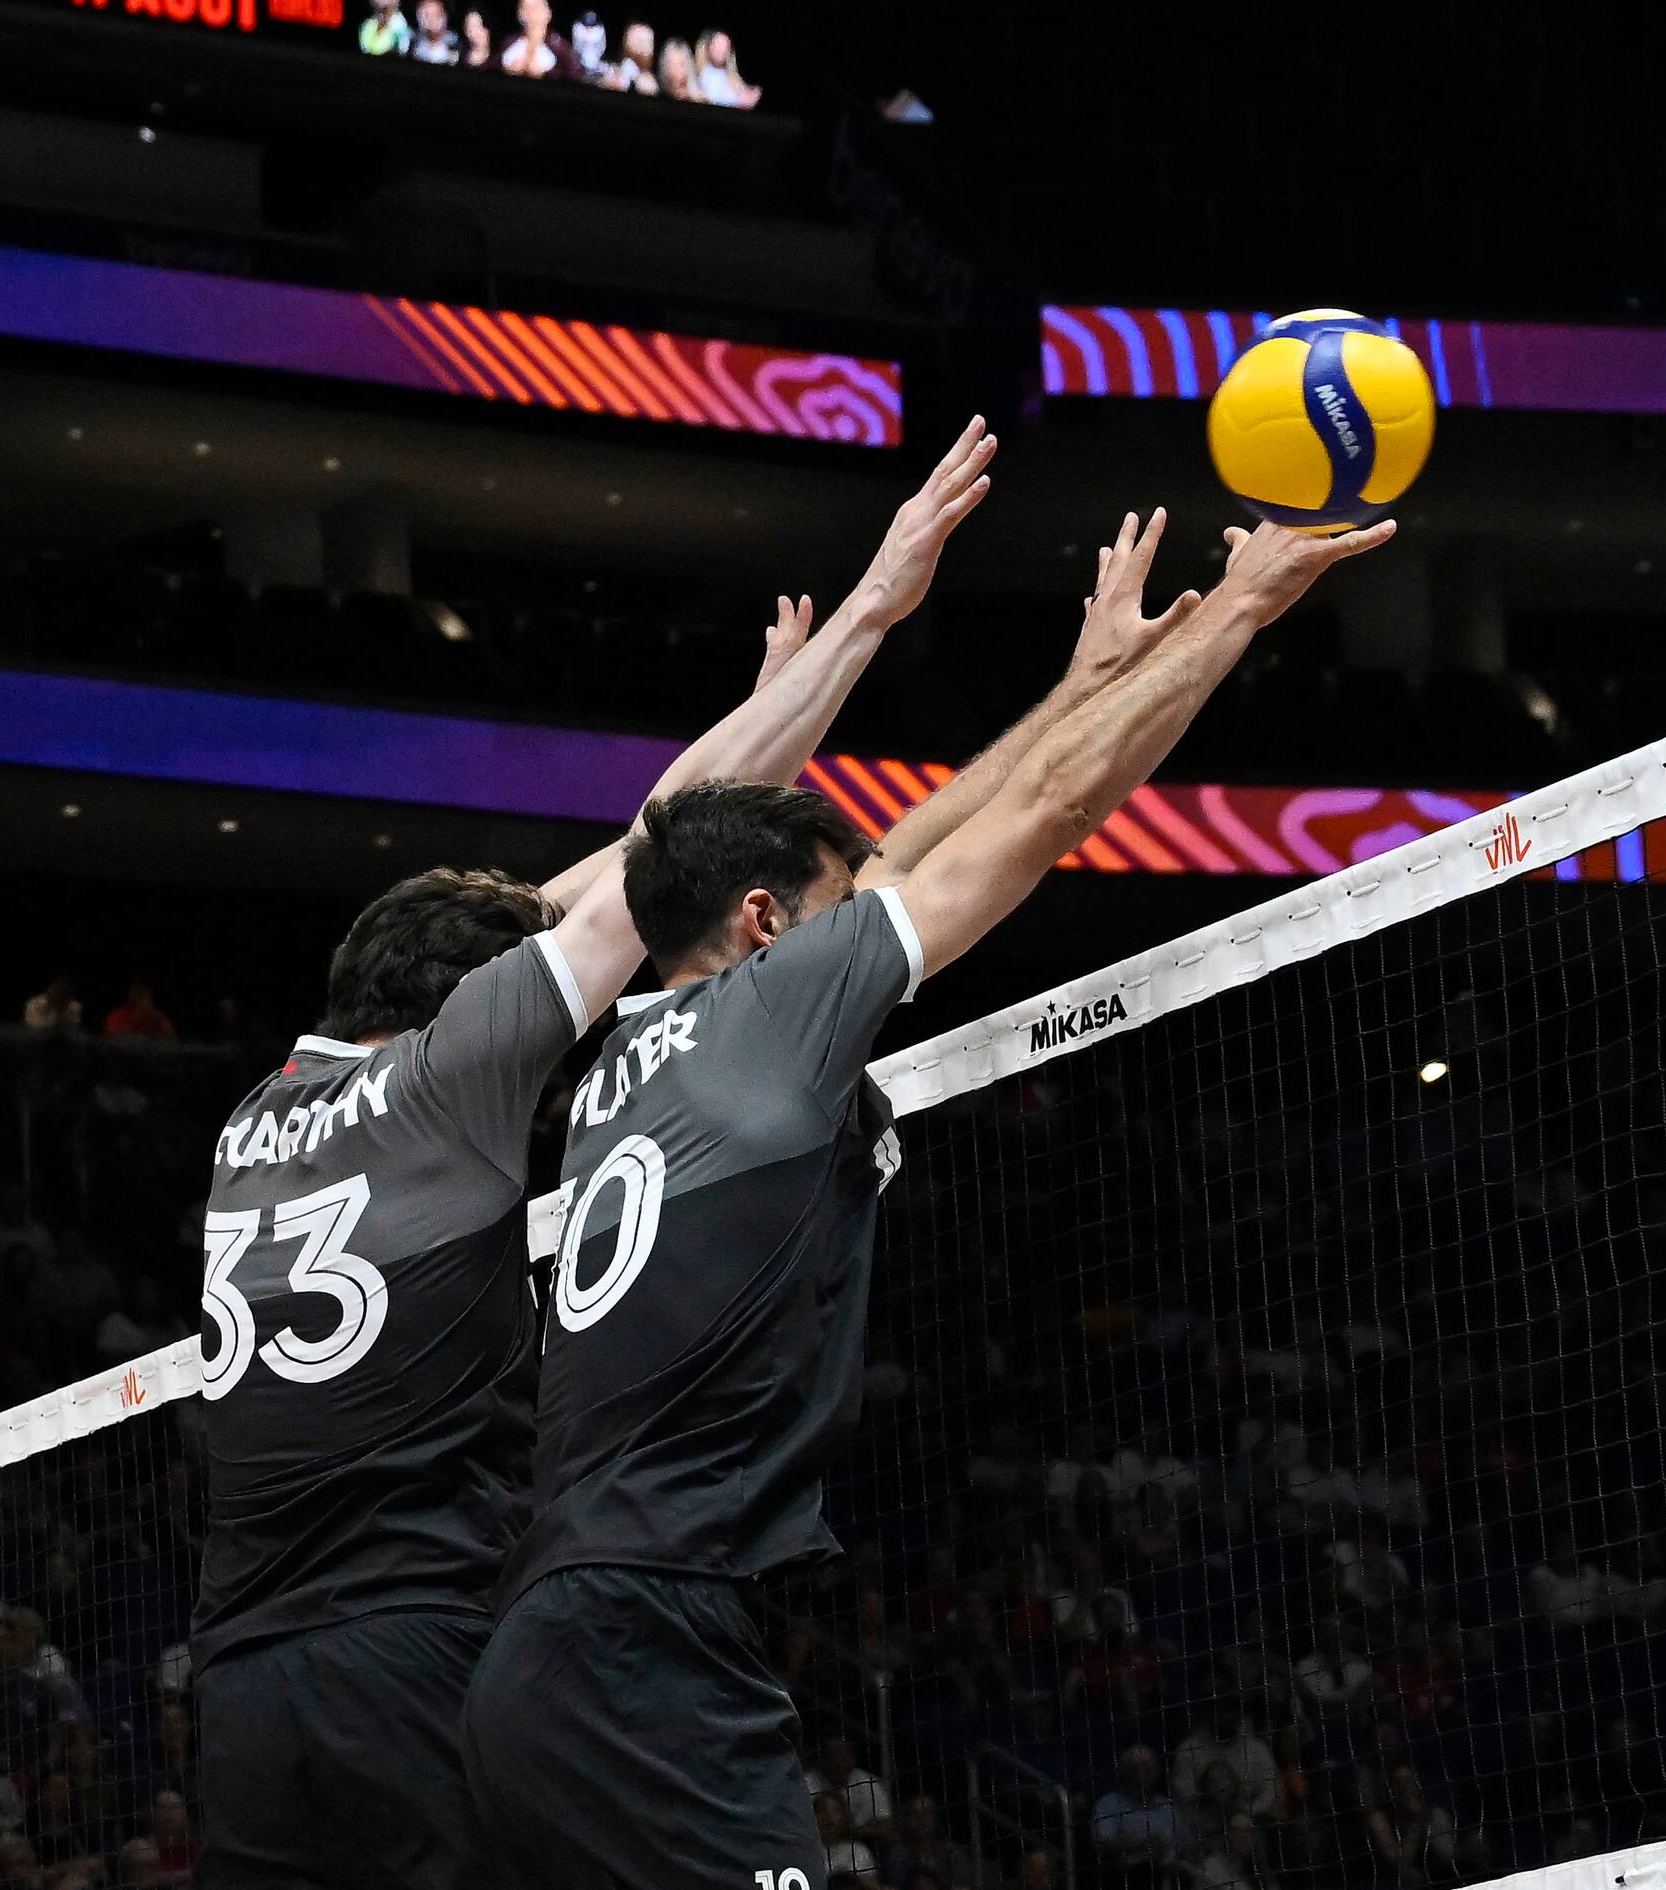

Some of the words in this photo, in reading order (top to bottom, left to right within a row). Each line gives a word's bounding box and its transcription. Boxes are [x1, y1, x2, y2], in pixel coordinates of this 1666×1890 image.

[1315, 384, 1362, 460] MIKASA
[1485, 812, 1532, 874] VNL
[1030, 993, 1128, 1053] MIKASA
[200, 1173, 389, 1402] 33
